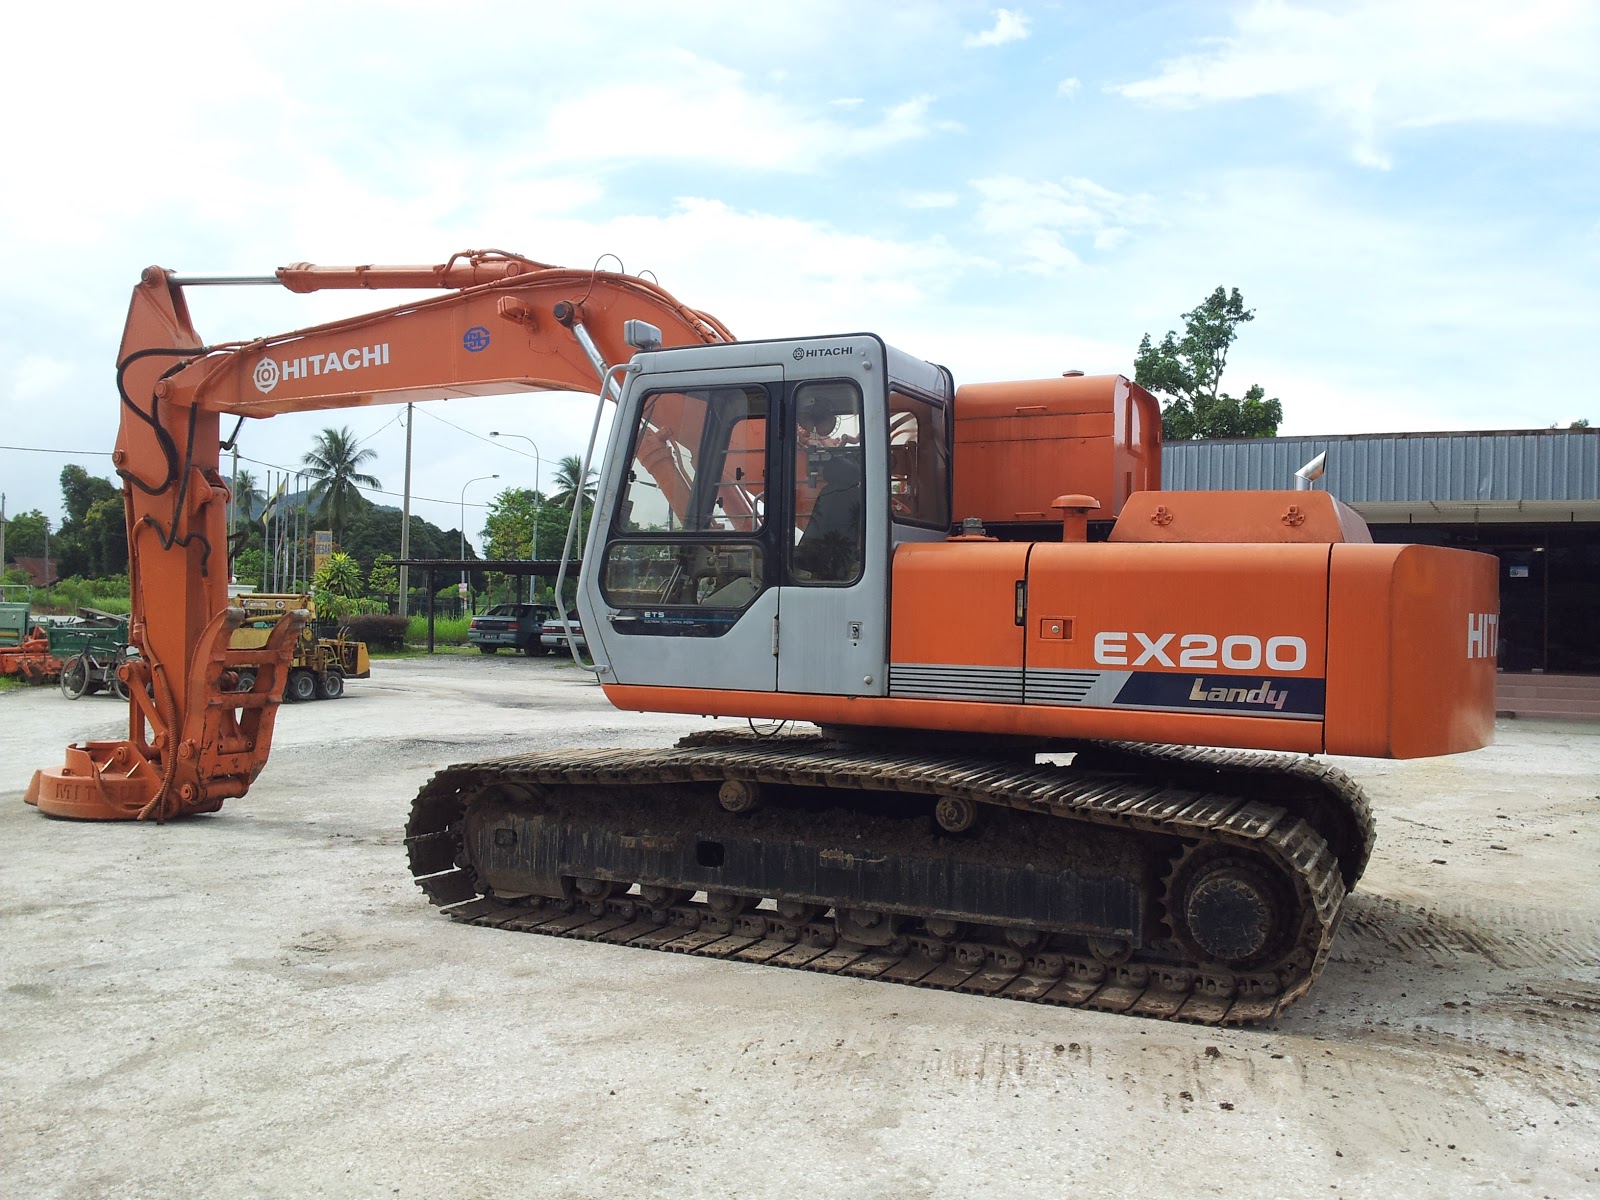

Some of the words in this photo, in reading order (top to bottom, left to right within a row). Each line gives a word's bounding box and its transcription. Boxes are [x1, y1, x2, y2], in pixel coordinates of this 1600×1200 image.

[282, 343, 389, 380] HITACHI
[806, 346, 853, 357] HITACHI
[1094, 631, 1307, 671] EX200
[1189, 677, 1289, 709] Landy
